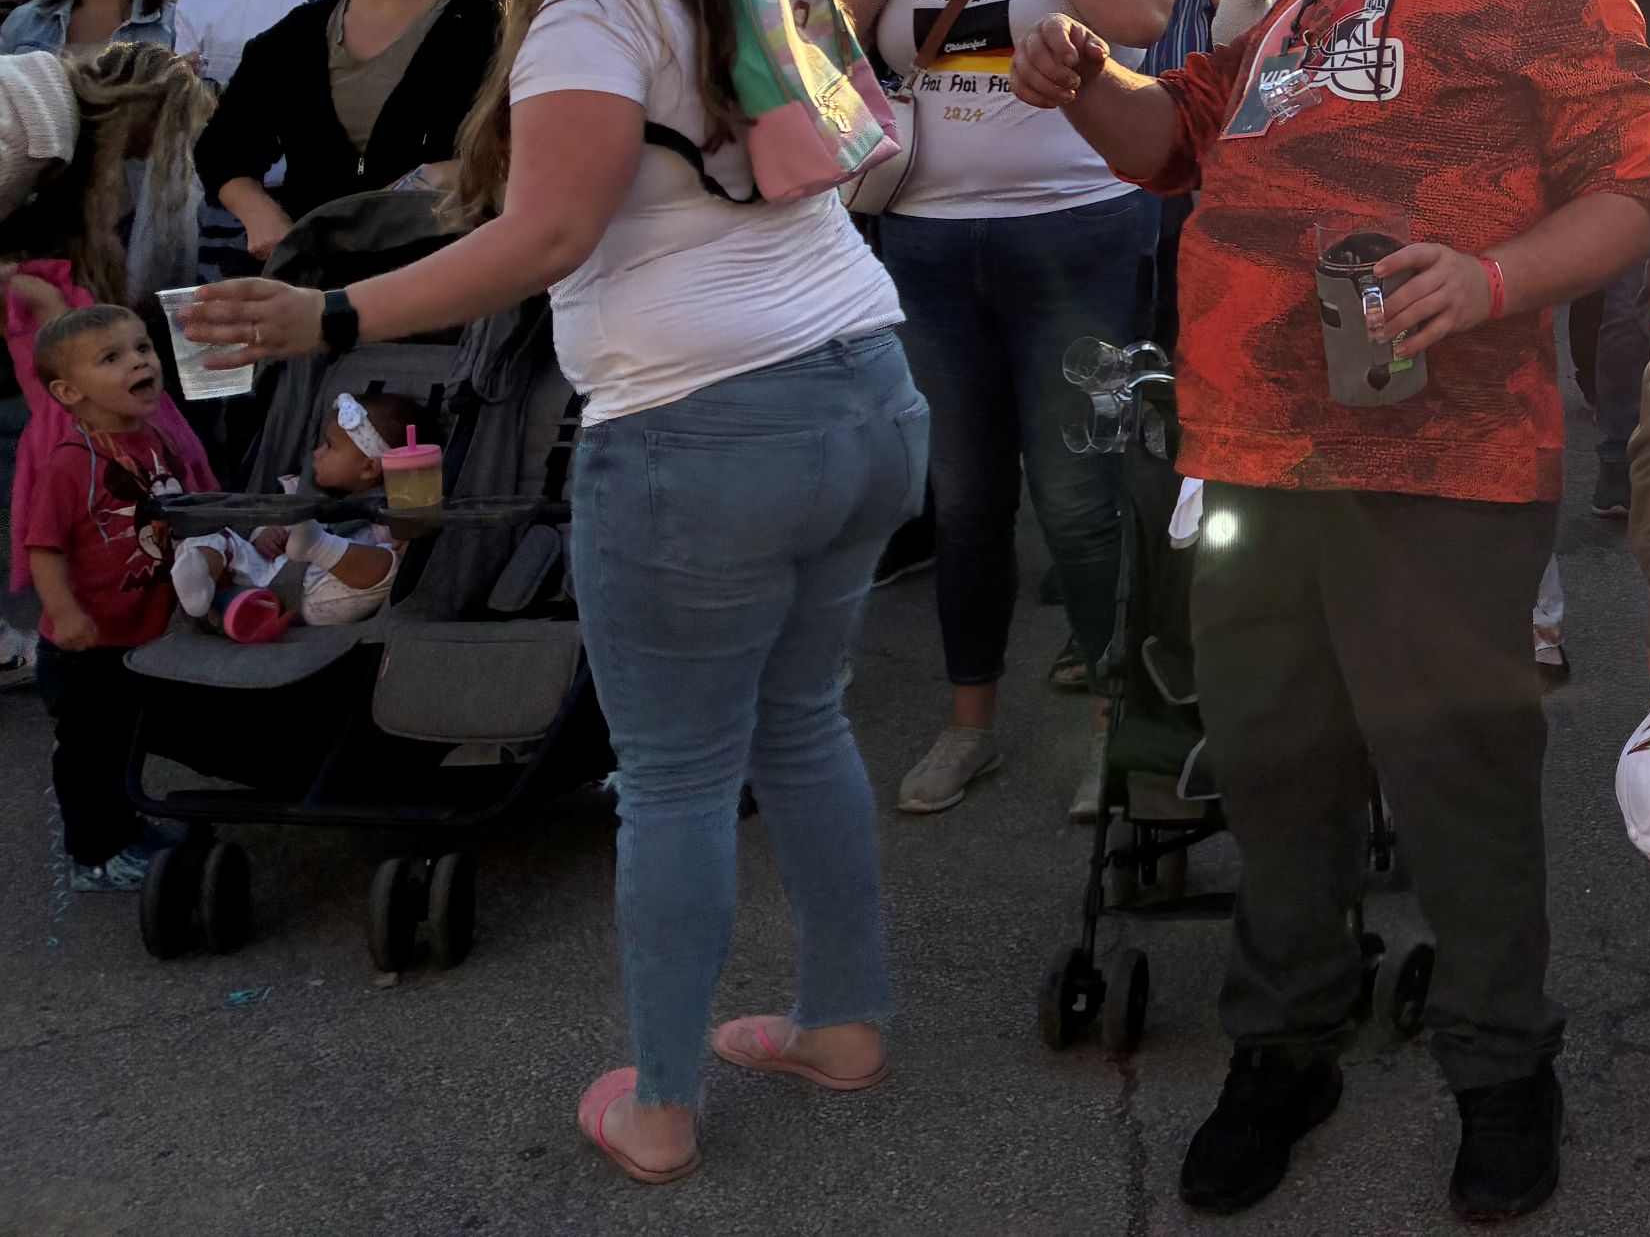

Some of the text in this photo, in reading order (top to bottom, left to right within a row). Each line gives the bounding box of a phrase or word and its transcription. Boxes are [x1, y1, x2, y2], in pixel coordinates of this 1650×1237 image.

[987, 75, 1012, 93] Ho
[1260, 69, 1290, 84] VIP
[943, 106, 985, 123] 2024
